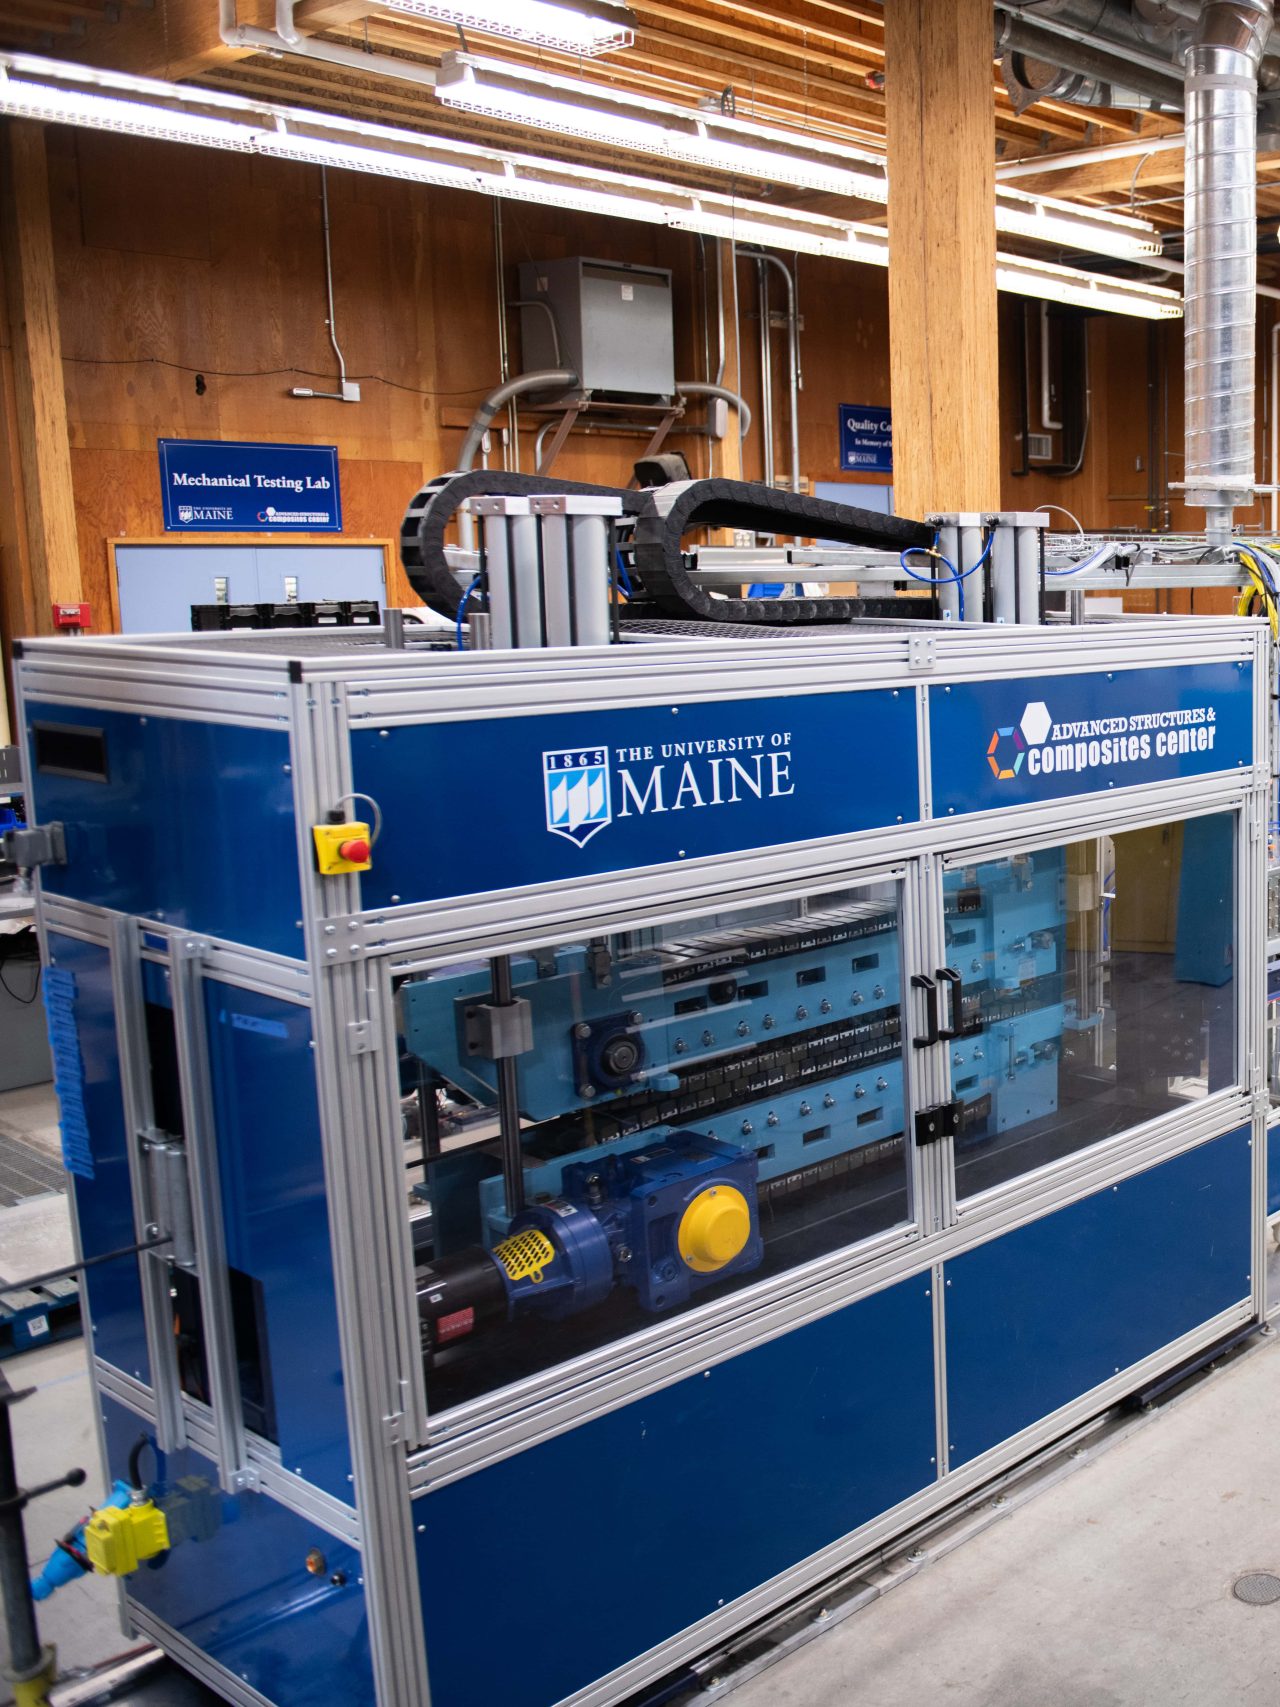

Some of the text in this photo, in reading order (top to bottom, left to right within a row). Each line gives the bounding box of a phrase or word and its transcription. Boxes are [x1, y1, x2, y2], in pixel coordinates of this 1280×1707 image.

[847, 418, 879, 434] Quality
[172, 472, 331, 493] Mechanical Testing Lab
[193, 510, 233, 520] MAINE
[1051, 706, 1216, 741] ADVANCED STRUCTURES &
[615, 732, 792, 763] THE UNIVERSITY OF
[549, 751, 603, 769] 1865
[617, 751, 795, 817] MAINE
